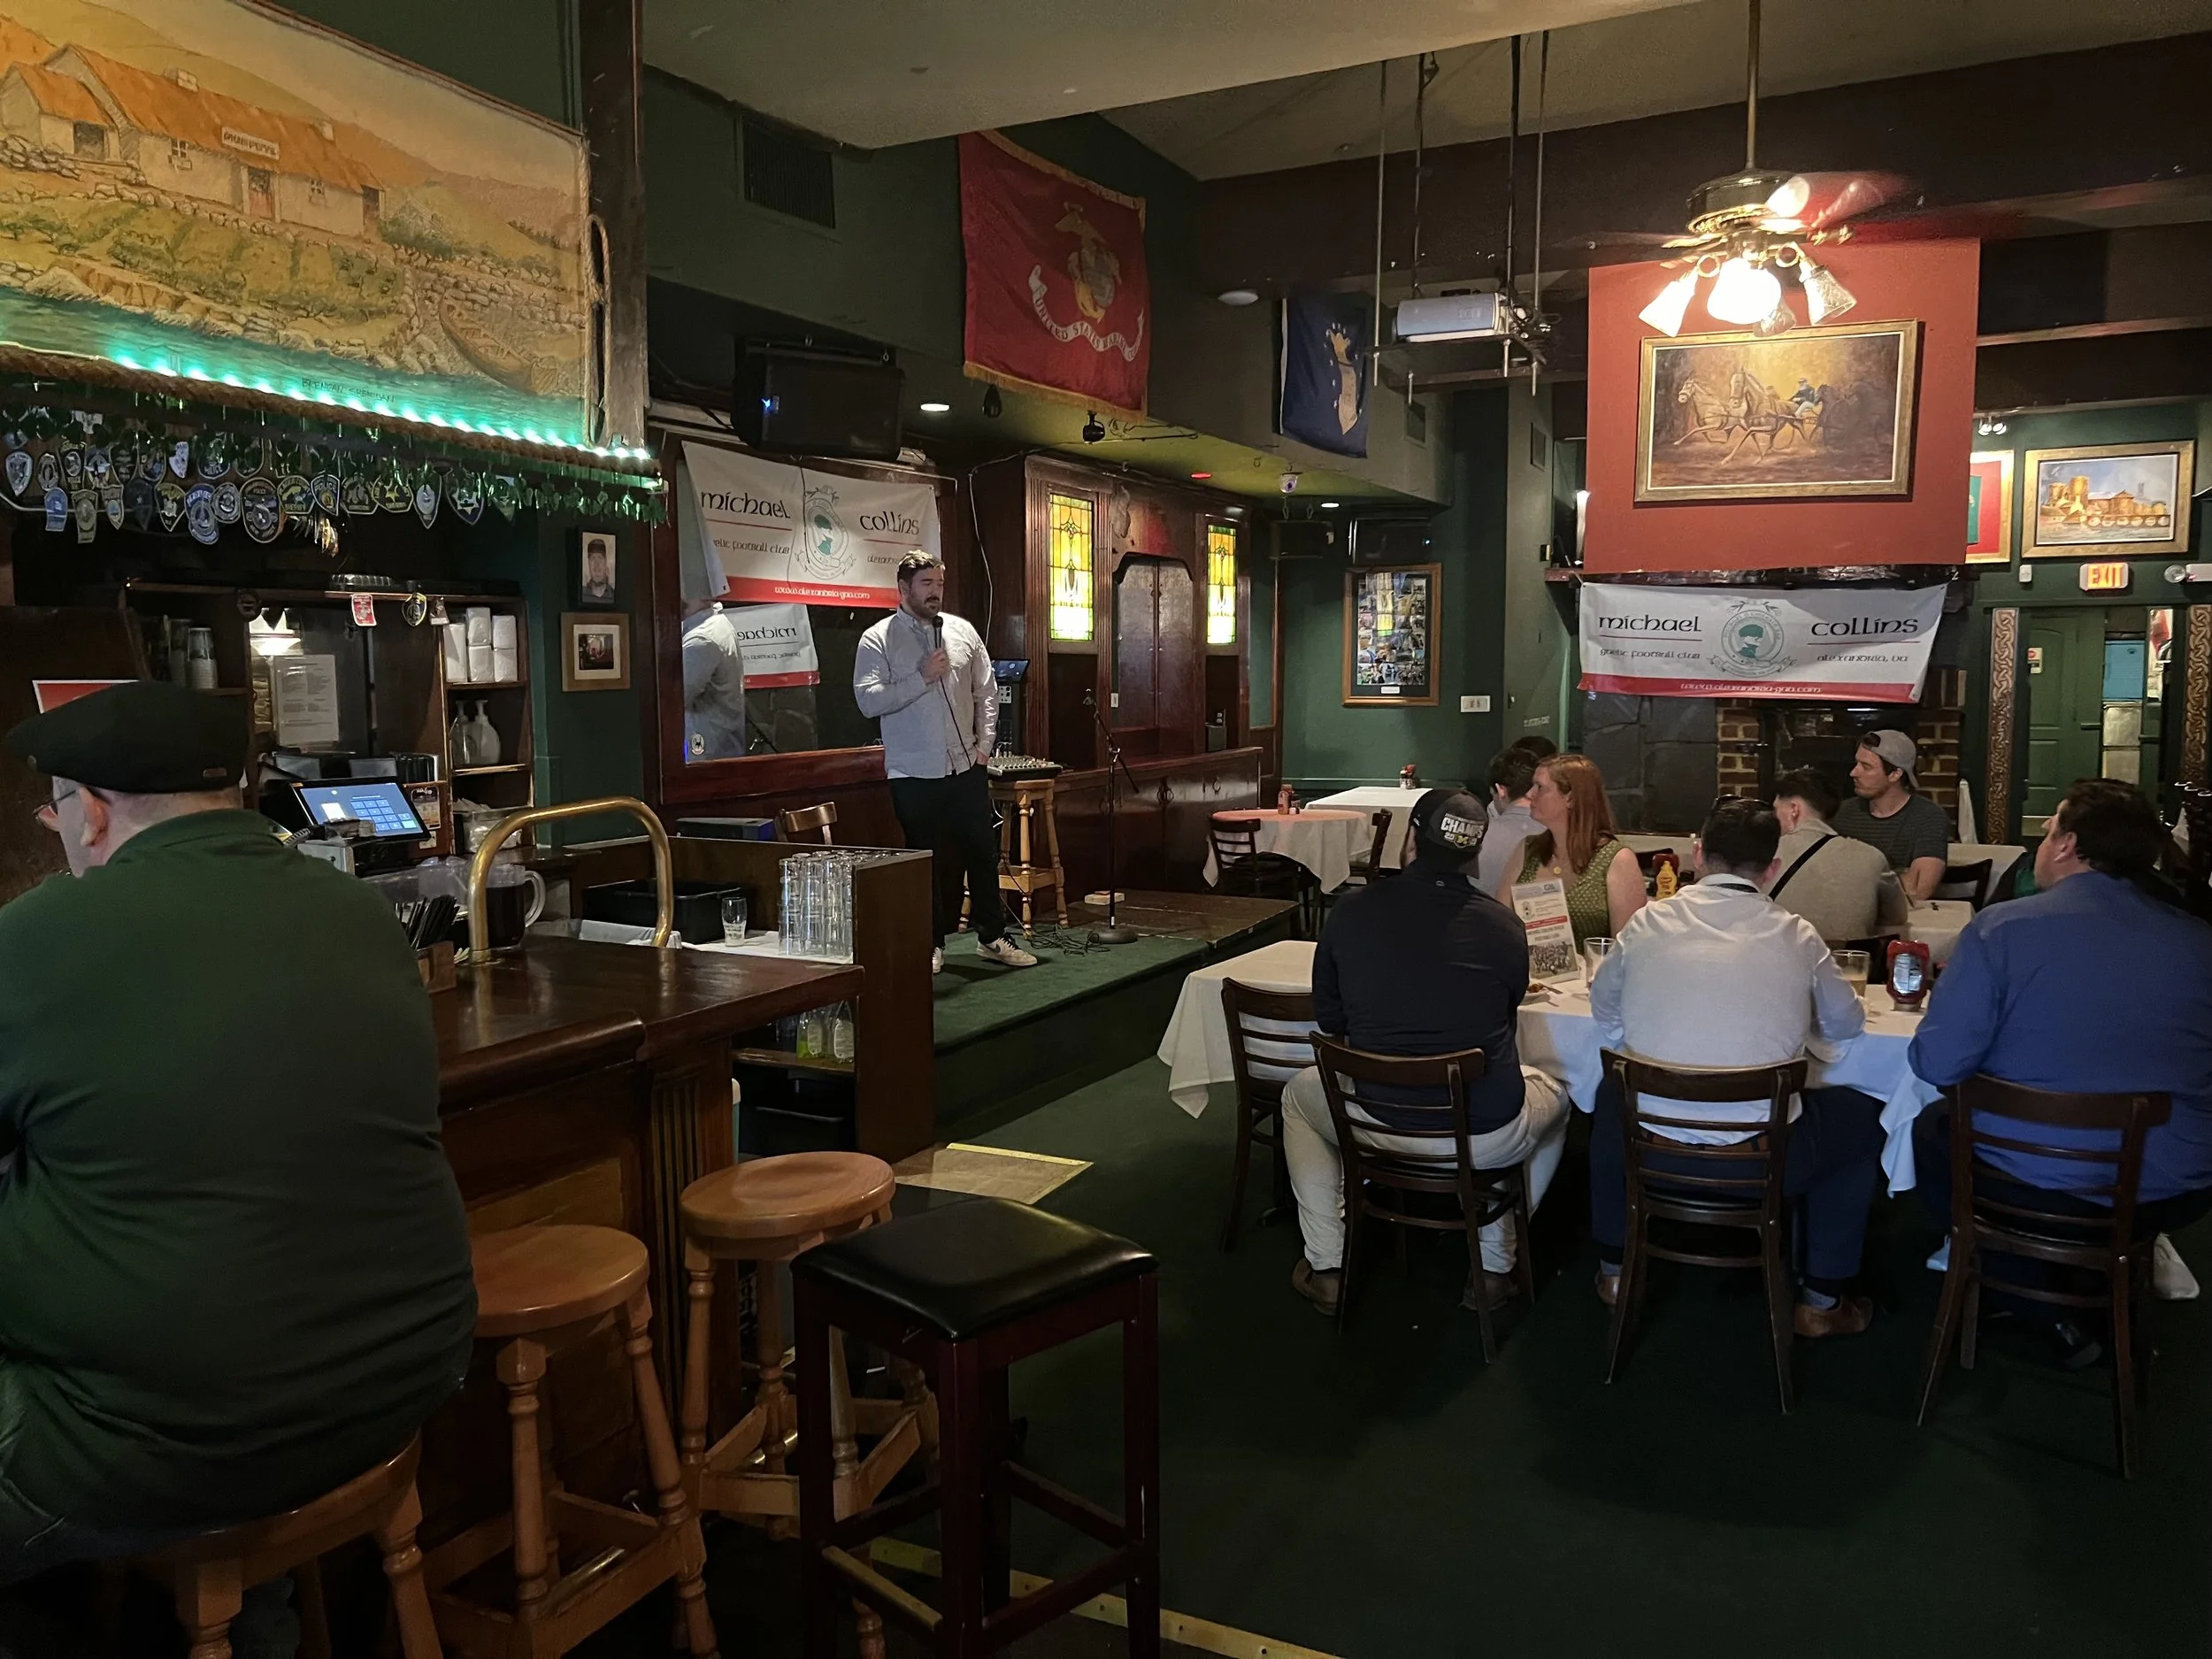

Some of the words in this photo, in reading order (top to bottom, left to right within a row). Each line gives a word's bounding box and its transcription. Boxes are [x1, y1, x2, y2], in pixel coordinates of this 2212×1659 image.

[1072, 322, 1100, 349] STATES
[701, 491, 791, 518] michael
[859, 511, 920, 535] collins
[2087, 563, 2124, 588] EXIT
[1599, 614, 1702, 633] michael
[1811, 617, 1918, 636] collins
[1440, 817, 1485, 839] CHAMPS
